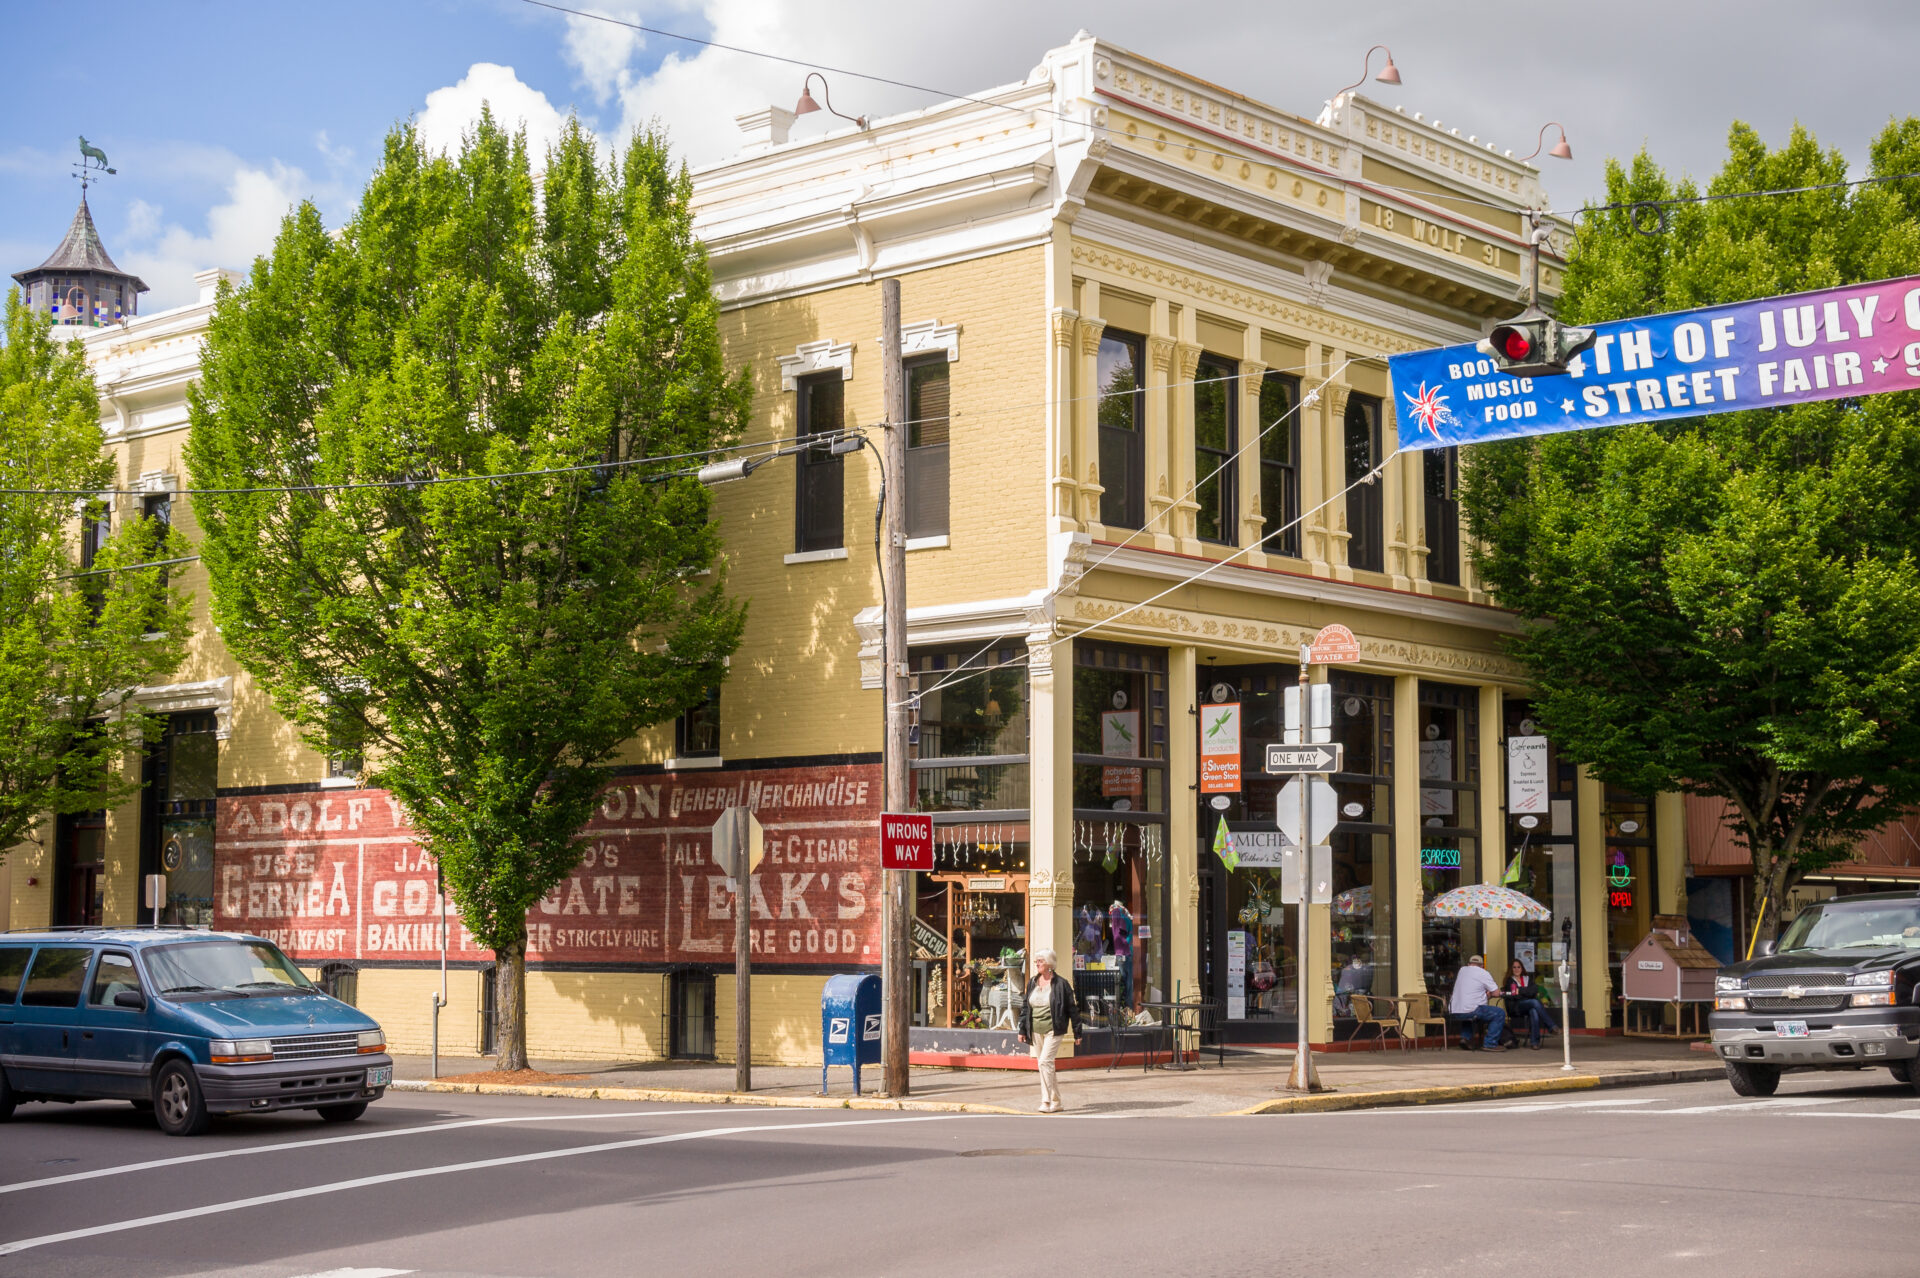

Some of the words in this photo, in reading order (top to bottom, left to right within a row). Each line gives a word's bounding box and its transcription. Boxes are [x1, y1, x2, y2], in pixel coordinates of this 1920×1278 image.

[1375, 205, 1394, 230] 18
[1411, 217, 1467, 254] WOLF
[1482, 244, 1501, 267] 91
[1673, 316, 1736, 364] OF
[1757, 294, 1880, 352] JULY
[1466, 376, 1534, 402] MUSIC
[1581, 366, 1740, 418] STREET
[1757, 351, 1864, 396] FAIR
[1484, 400, 1538, 423] FOOD
[1315, 653, 1344, 662] WATER
[1272, 753, 1292, 764] ONE
[1297, 752, 1318, 765] WAY
[1526, 743, 1547, 751] earth
[1202, 772, 1223, 781] Green
[1223, 771, 1239, 781] Store
[1207, 759, 1239, 772] Silverton
[227, 797, 372, 836] ADOLF
[886, 822, 928, 841] WRONG
[674, 842, 705, 866] ALL
[787, 834, 859, 865] CIGARS
[895, 845, 921, 862] WAY
[1420, 848, 1461, 866] ESPRESSO
[253, 853, 315, 877] USE
[221, 861, 351, 919] GERMEA
[1611, 891, 1632, 907] OPEN
[678, 871, 867, 953] LEAK'S
[367, 923, 449, 952] BAKING
[556, 929, 623, 948] STRICTLY
[625, 928, 659, 948] PURE
[789, 928, 871, 955] GOOD.
